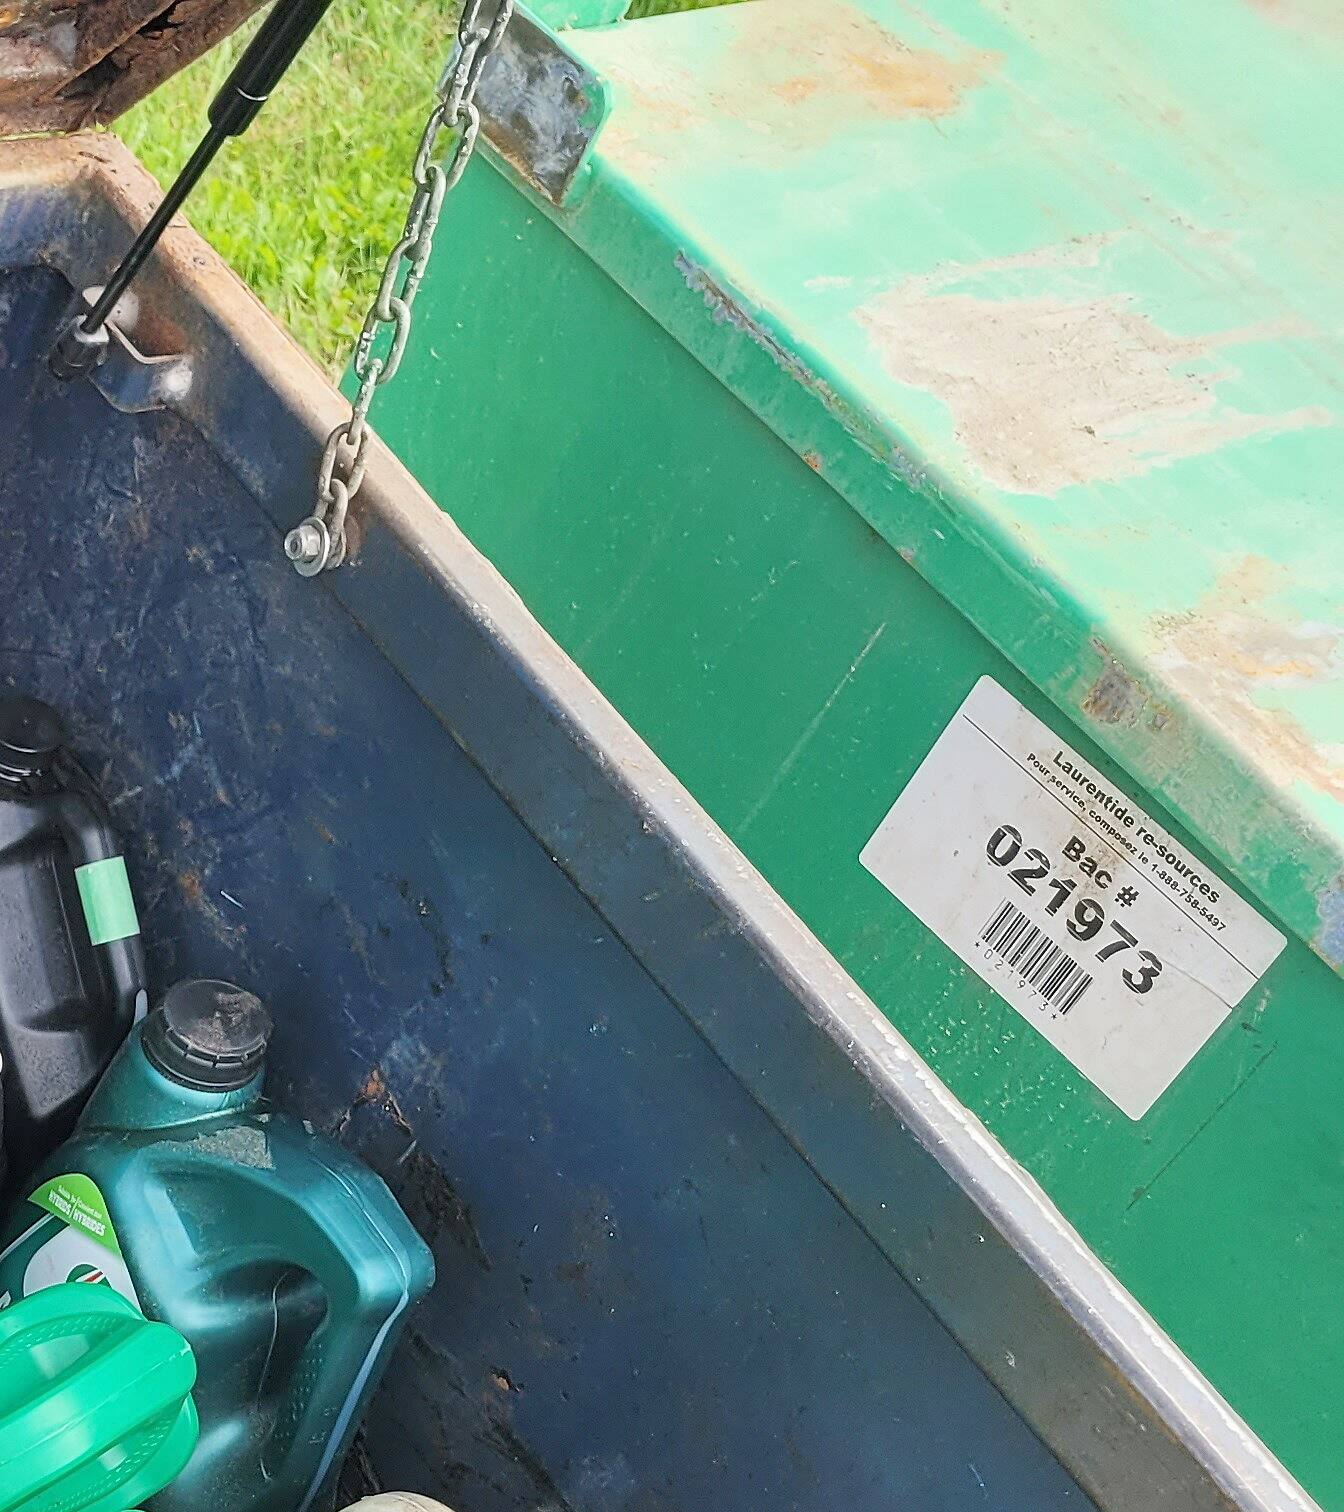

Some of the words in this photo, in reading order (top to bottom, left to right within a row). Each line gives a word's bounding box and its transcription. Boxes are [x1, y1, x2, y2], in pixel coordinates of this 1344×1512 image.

[1026, 752, 1051, 780] Pour
[1049, 774, 1088, 816] service,
[1088, 808, 1139, 855] composez
[1137, 850, 1150, 866] le
[1150, 863, 1227, 932] 1-888-758-5497
[1053, 750, 1136, 828] Laurentide
[1135, 824, 1222, 904] re-sources
[1062, 834, 1113, 890] Bac
[1116, 885, 1140, 909] #
[985, 824, 1164, 996] 021973
